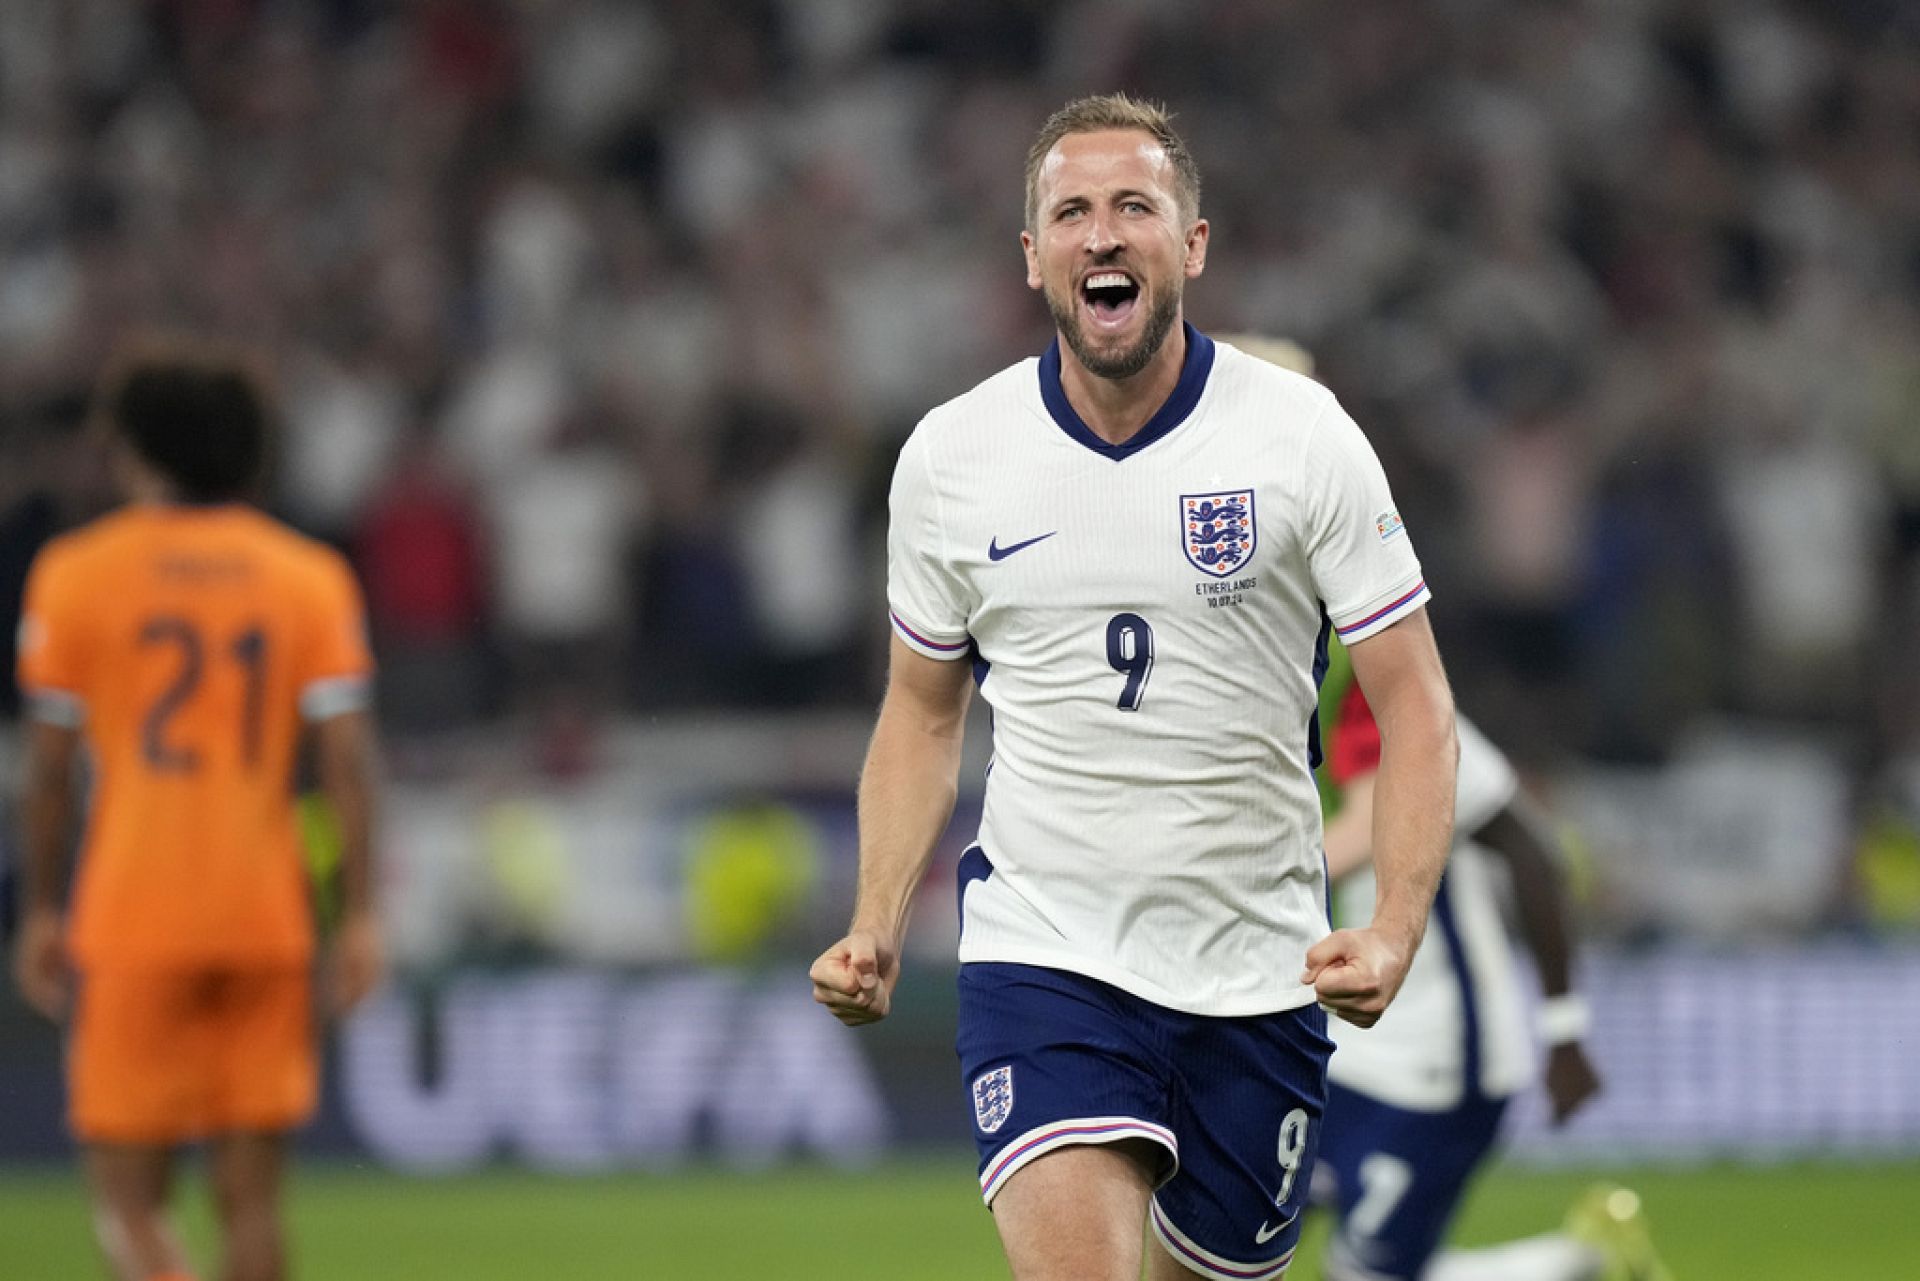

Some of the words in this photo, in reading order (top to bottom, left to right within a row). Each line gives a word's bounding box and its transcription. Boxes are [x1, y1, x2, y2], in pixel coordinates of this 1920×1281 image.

[137, 612, 269, 775] 21
[1105, 612, 1154, 711] 9
[1275, 1107, 1308, 1207] 9
[1347, 1152, 1414, 1238] 7
